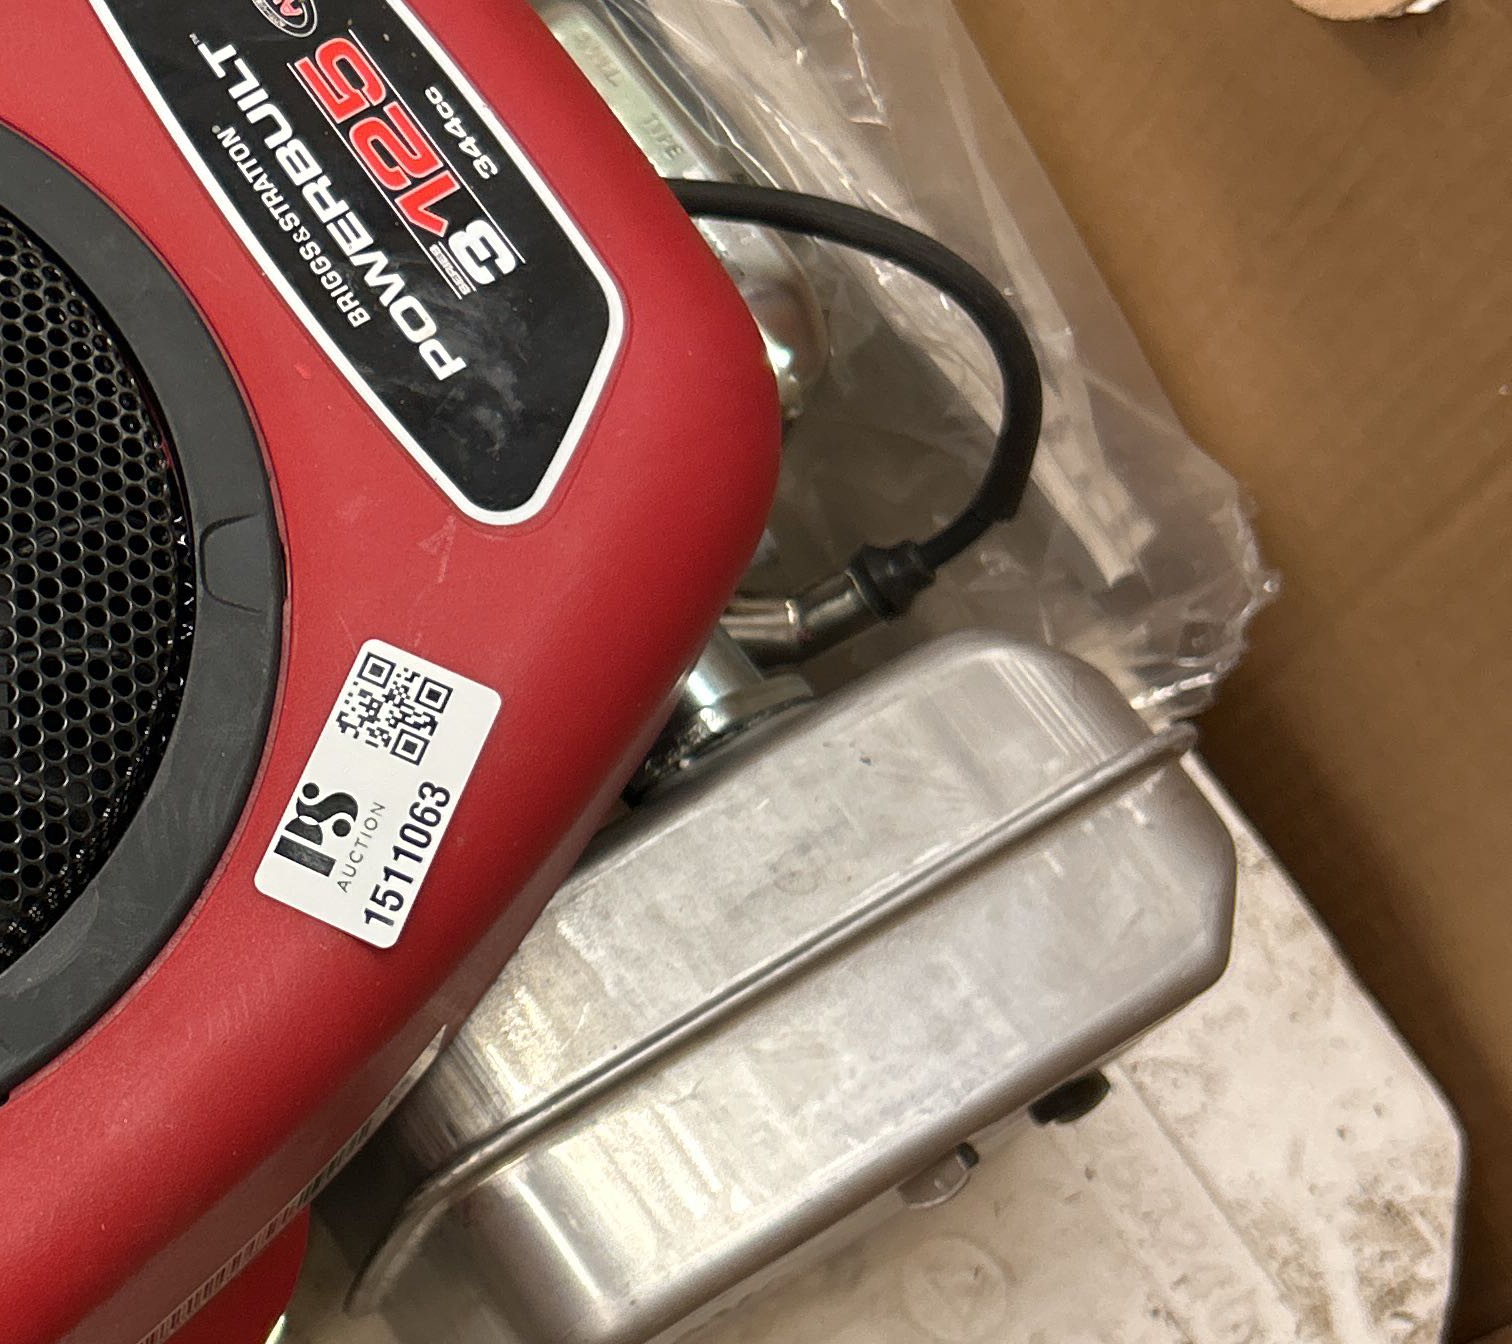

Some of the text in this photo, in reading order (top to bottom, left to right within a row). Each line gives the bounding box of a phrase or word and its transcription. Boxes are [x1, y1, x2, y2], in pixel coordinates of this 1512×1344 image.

[424, 86, 499, 180] 344cc
[336, 801, 386, 893] AUCTION
[363, 780, 451, 927] 1511063
